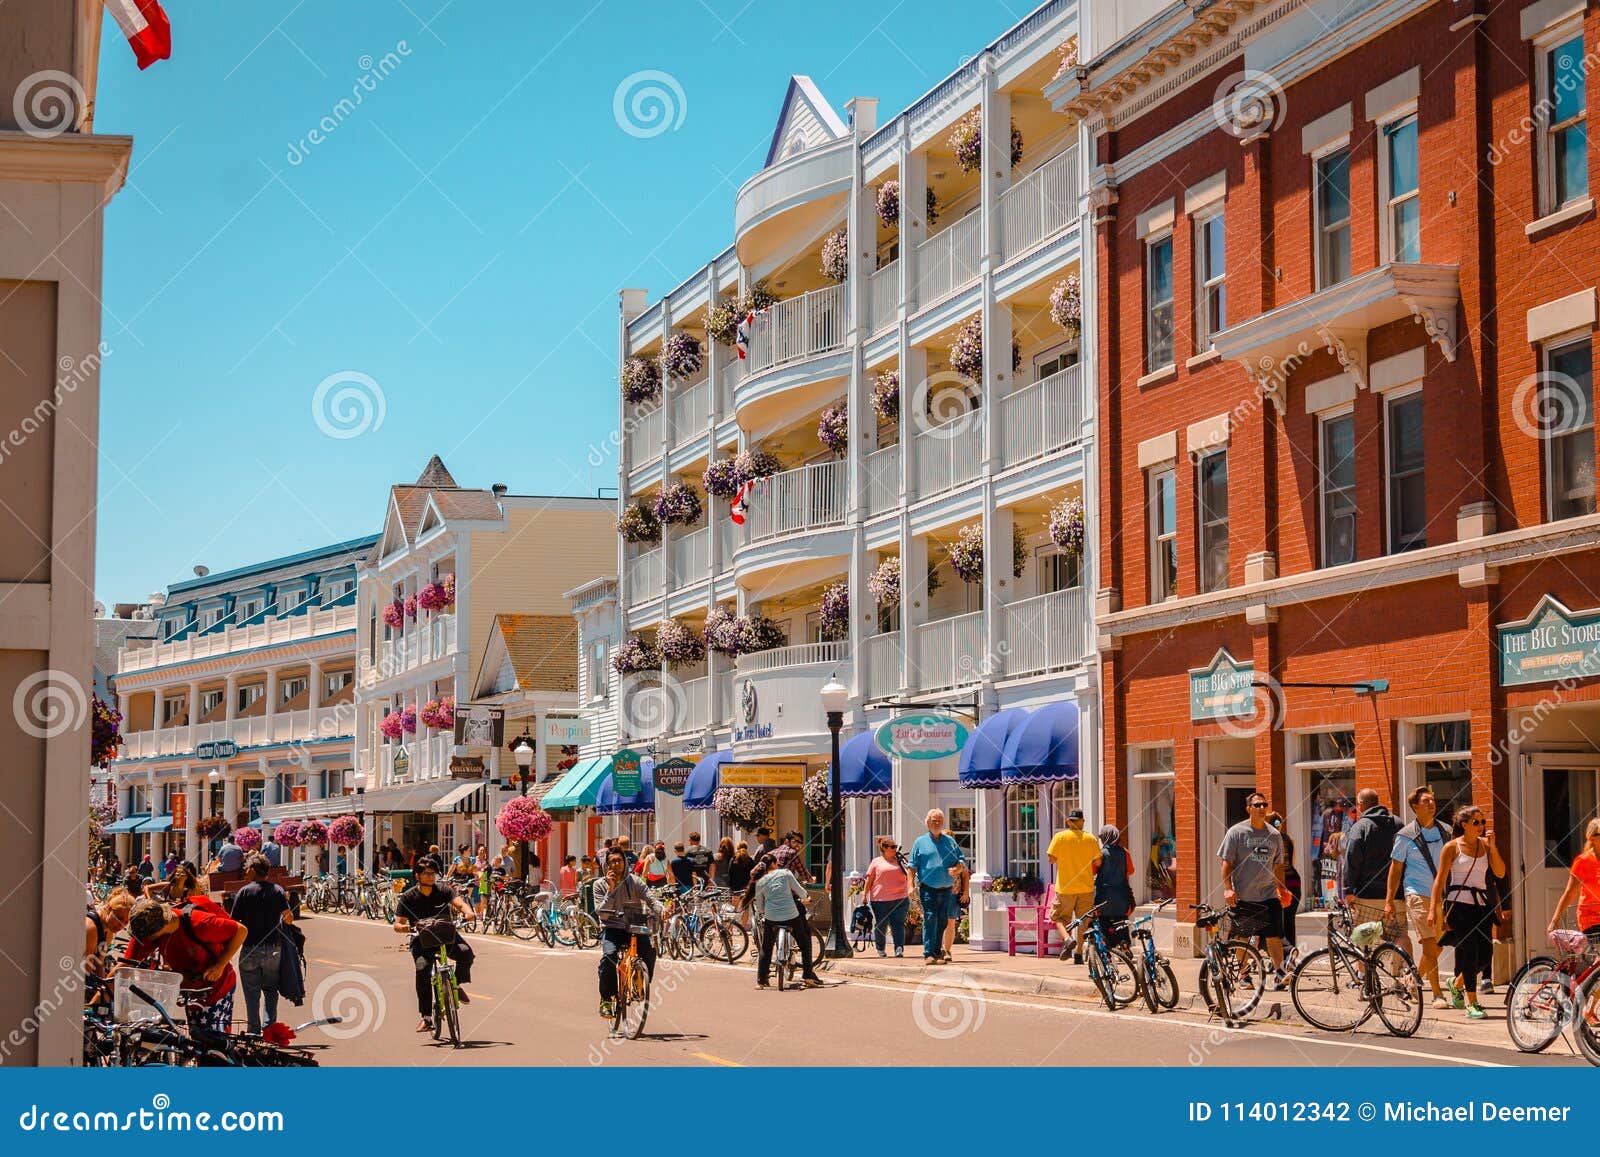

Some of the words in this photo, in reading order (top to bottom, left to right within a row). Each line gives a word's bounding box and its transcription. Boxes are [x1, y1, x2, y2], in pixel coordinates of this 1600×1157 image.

[1504, 634, 1527, 653] THE
[1531, 626, 1557, 650] BIG
[1194, 679, 1209, 693] THE
[1211, 673, 1228, 691] BIG
[660, 776, 688, 785] CORRA
